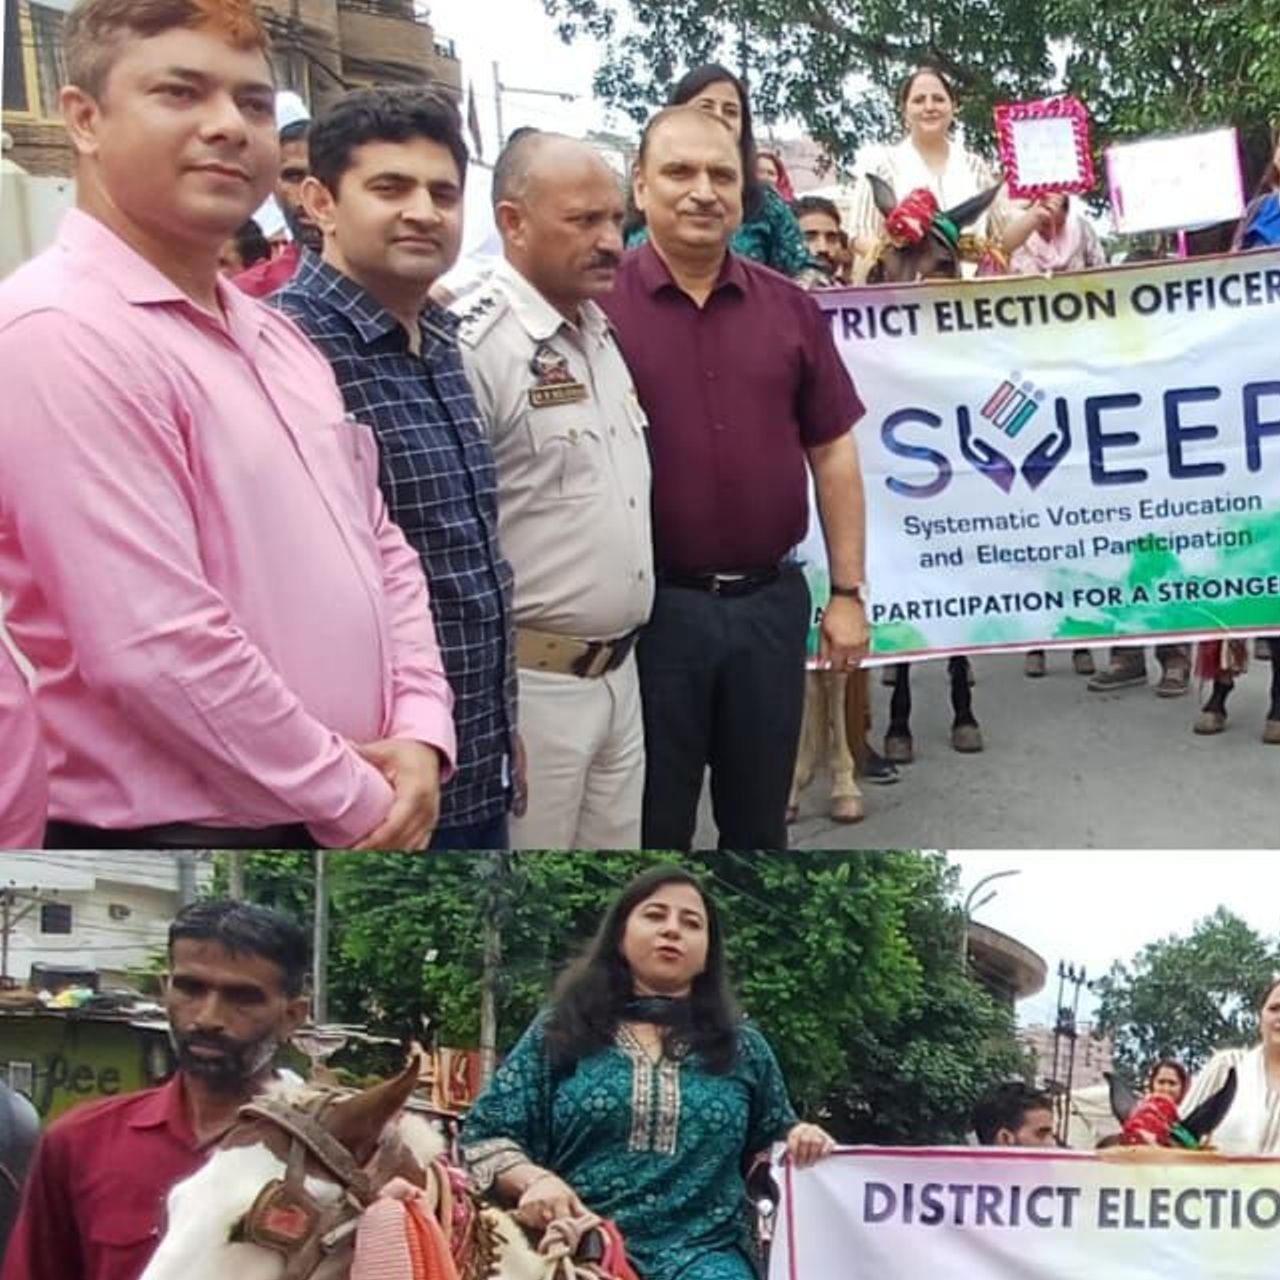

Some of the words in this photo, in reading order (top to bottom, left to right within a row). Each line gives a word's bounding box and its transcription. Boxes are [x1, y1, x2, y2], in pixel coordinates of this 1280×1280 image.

[821, 303, 920, 340] TRICT
[933, 288, 1116, 334] ELECTION
[903, 510, 1040, 538] Systematic
[1046, 501, 1132, 527] Voters
[1139, 493, 1262, 519] Education
[919, 546, 963, 569] and
[976, 538, 1085, 566] Electoral
[1093, 526, 1253, 557] Participation
[873, 590, 1063, 623] PARTICIPATION
[1073, 586, 1122, 608] FOR
[1131, 585, 1151, 606] A
[863, 1181, 1080, 1226] DISTRICT
